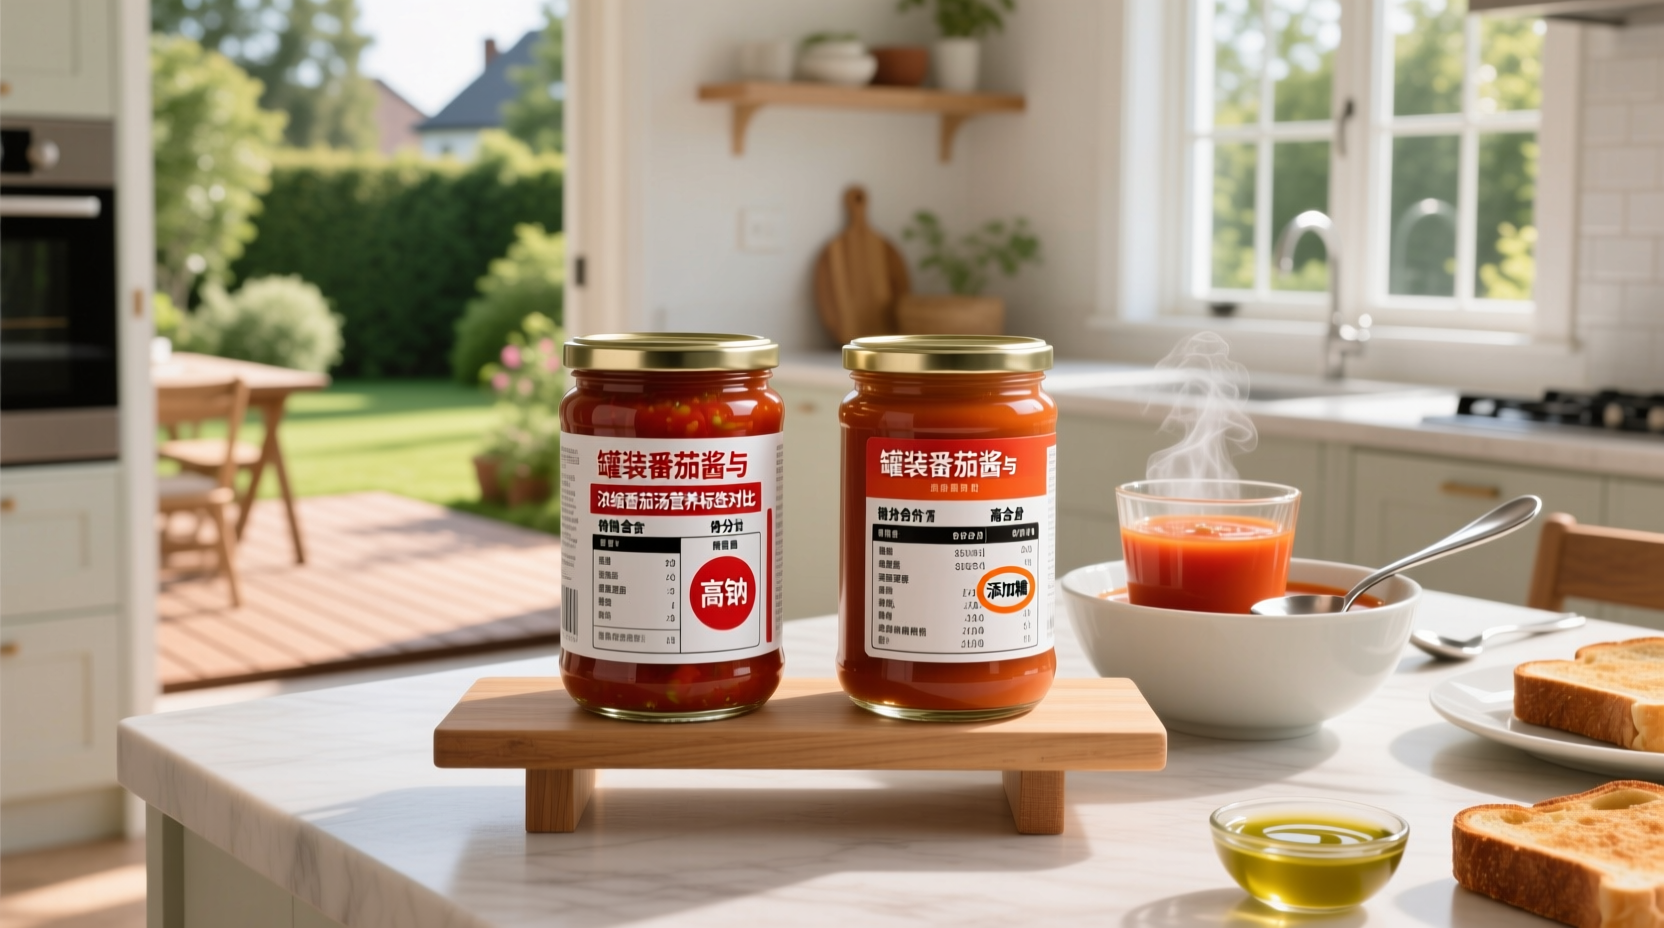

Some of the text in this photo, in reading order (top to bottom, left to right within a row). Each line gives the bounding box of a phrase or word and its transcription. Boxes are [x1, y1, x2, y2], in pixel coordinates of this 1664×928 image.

[597, 449, 748, 480] 罐装番茄酱与
[880, 449, 1017, 478] 罐装番茄酱与
[700, 577, 748, 608] 高钠
